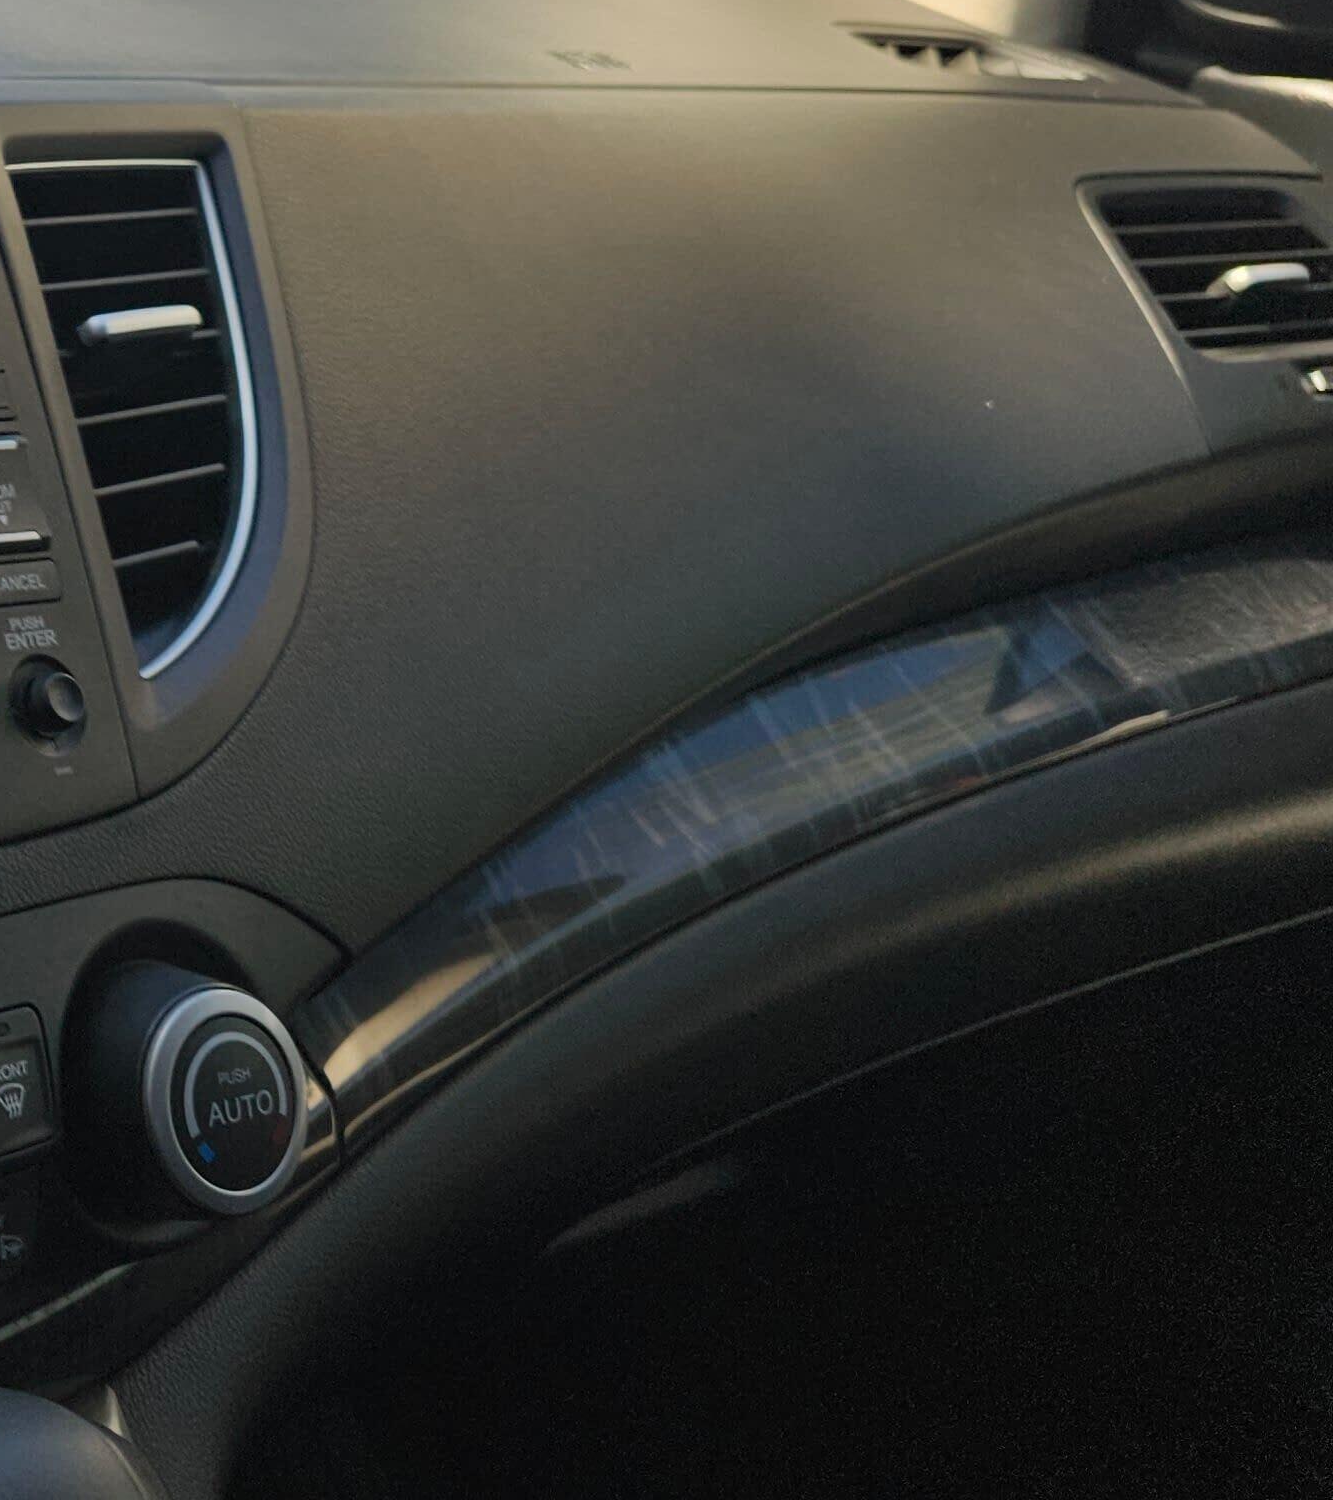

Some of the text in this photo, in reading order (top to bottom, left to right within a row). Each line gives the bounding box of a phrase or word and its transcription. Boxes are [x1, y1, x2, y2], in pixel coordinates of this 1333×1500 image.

[8, 616, 45, 631] PUSH
[5, 629, 59, 650] ENTER
[217, 1067, 252, 1085] PUSH
[207, 1090, 274, 1129] AUTO
